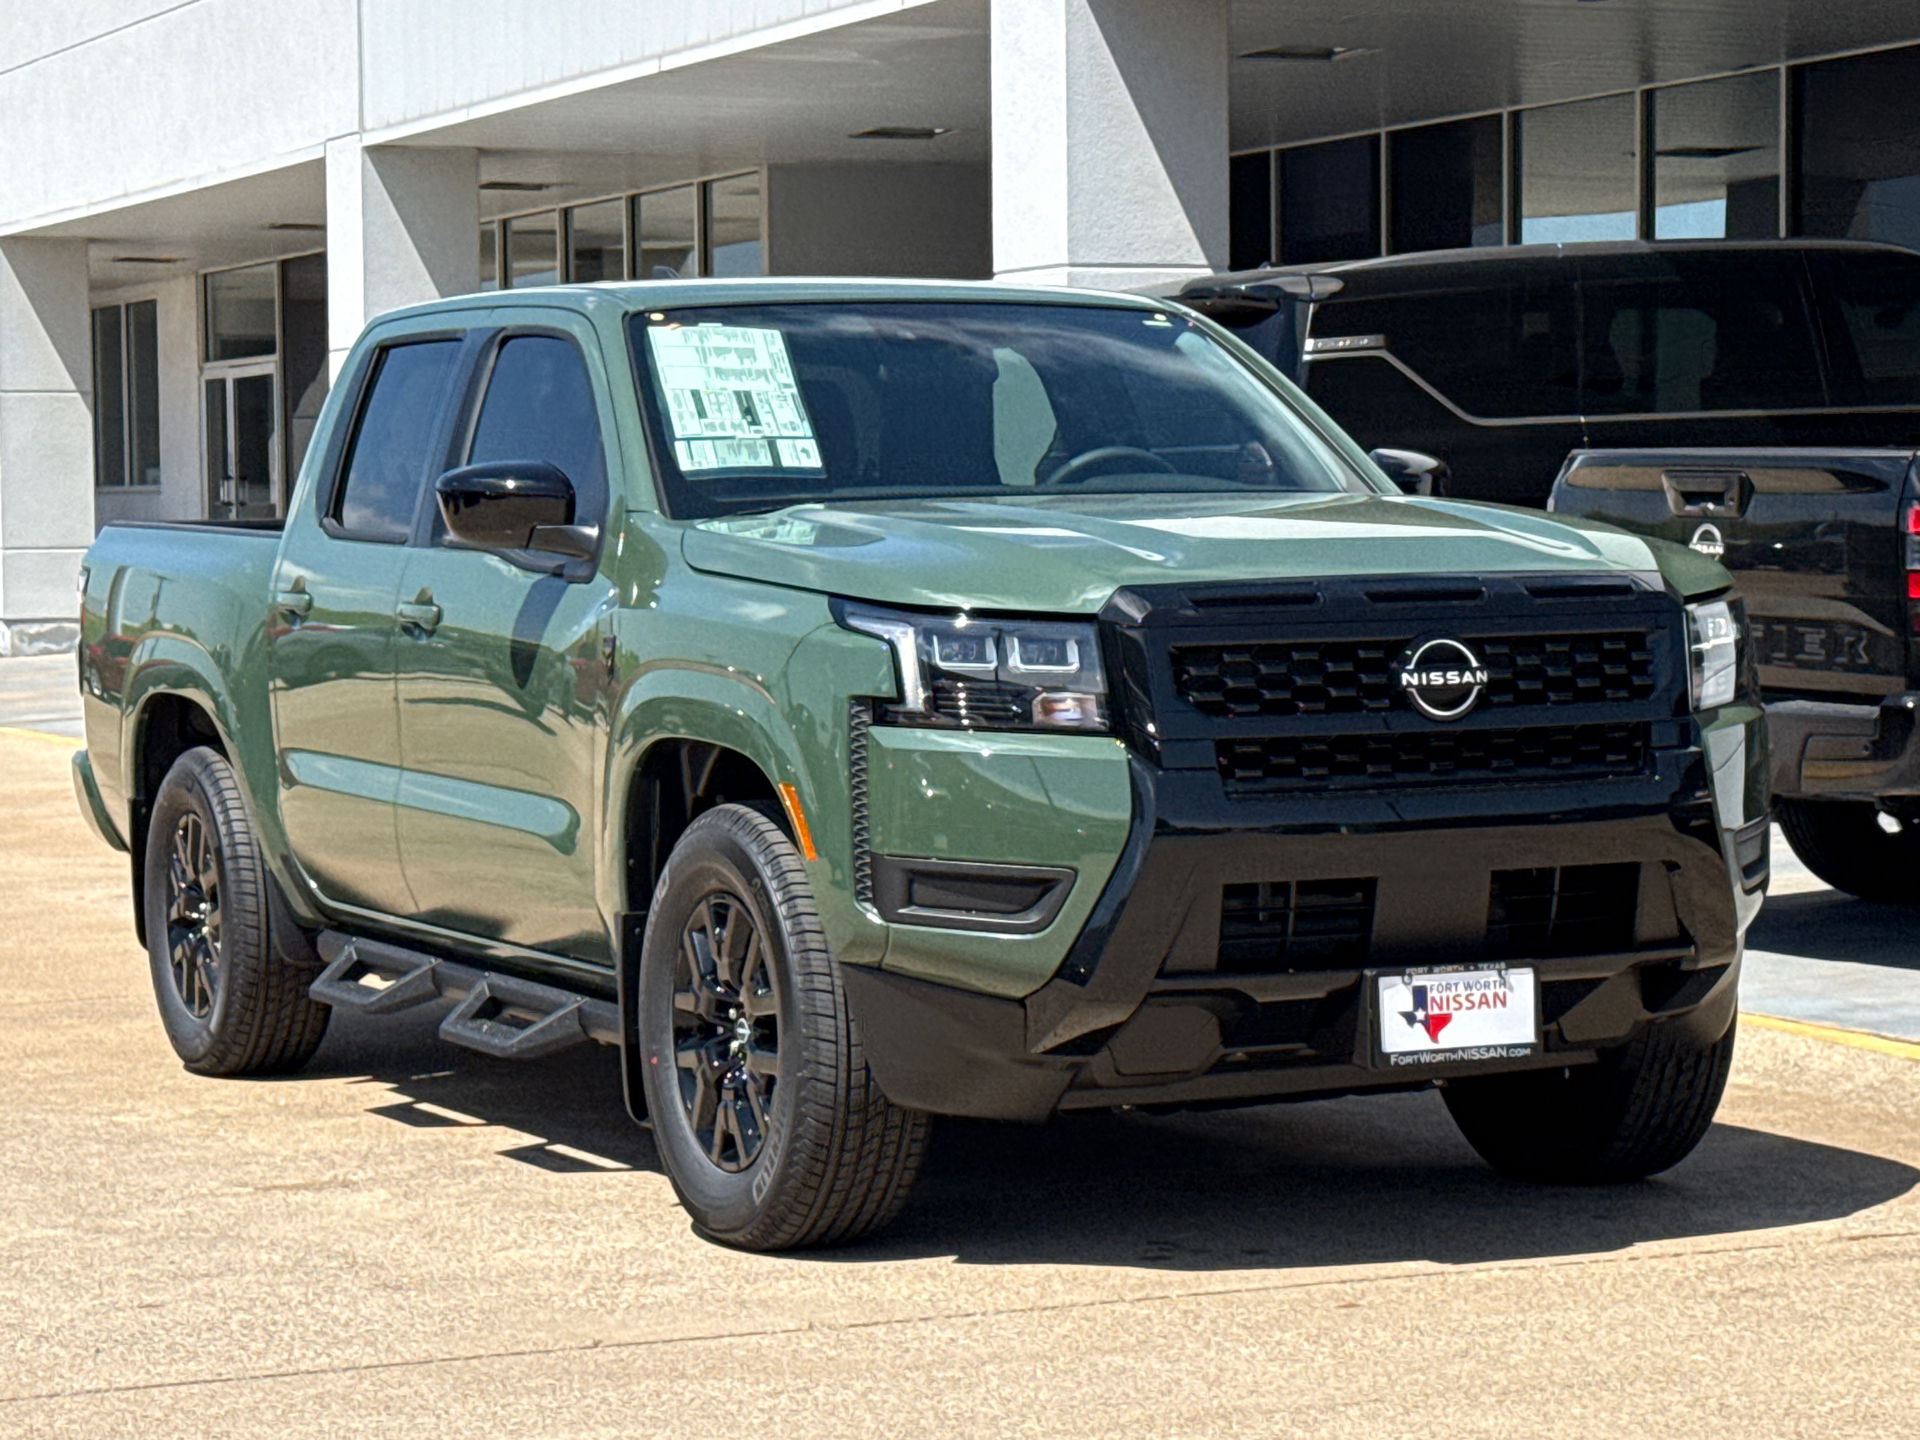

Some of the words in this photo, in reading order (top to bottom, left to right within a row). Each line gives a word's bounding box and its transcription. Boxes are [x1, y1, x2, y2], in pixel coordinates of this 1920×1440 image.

[1401, 670, 1488, 686] NISSAN
[1433, 965, 1464, 973] WORTH
[1477, 961, 1506, 971] TEXAS
[1429, 981, 1460, 994] FORT
[1463, 979, 1507, 992] WORTH
[1429, 991, 1507, 1012] NISSAN
